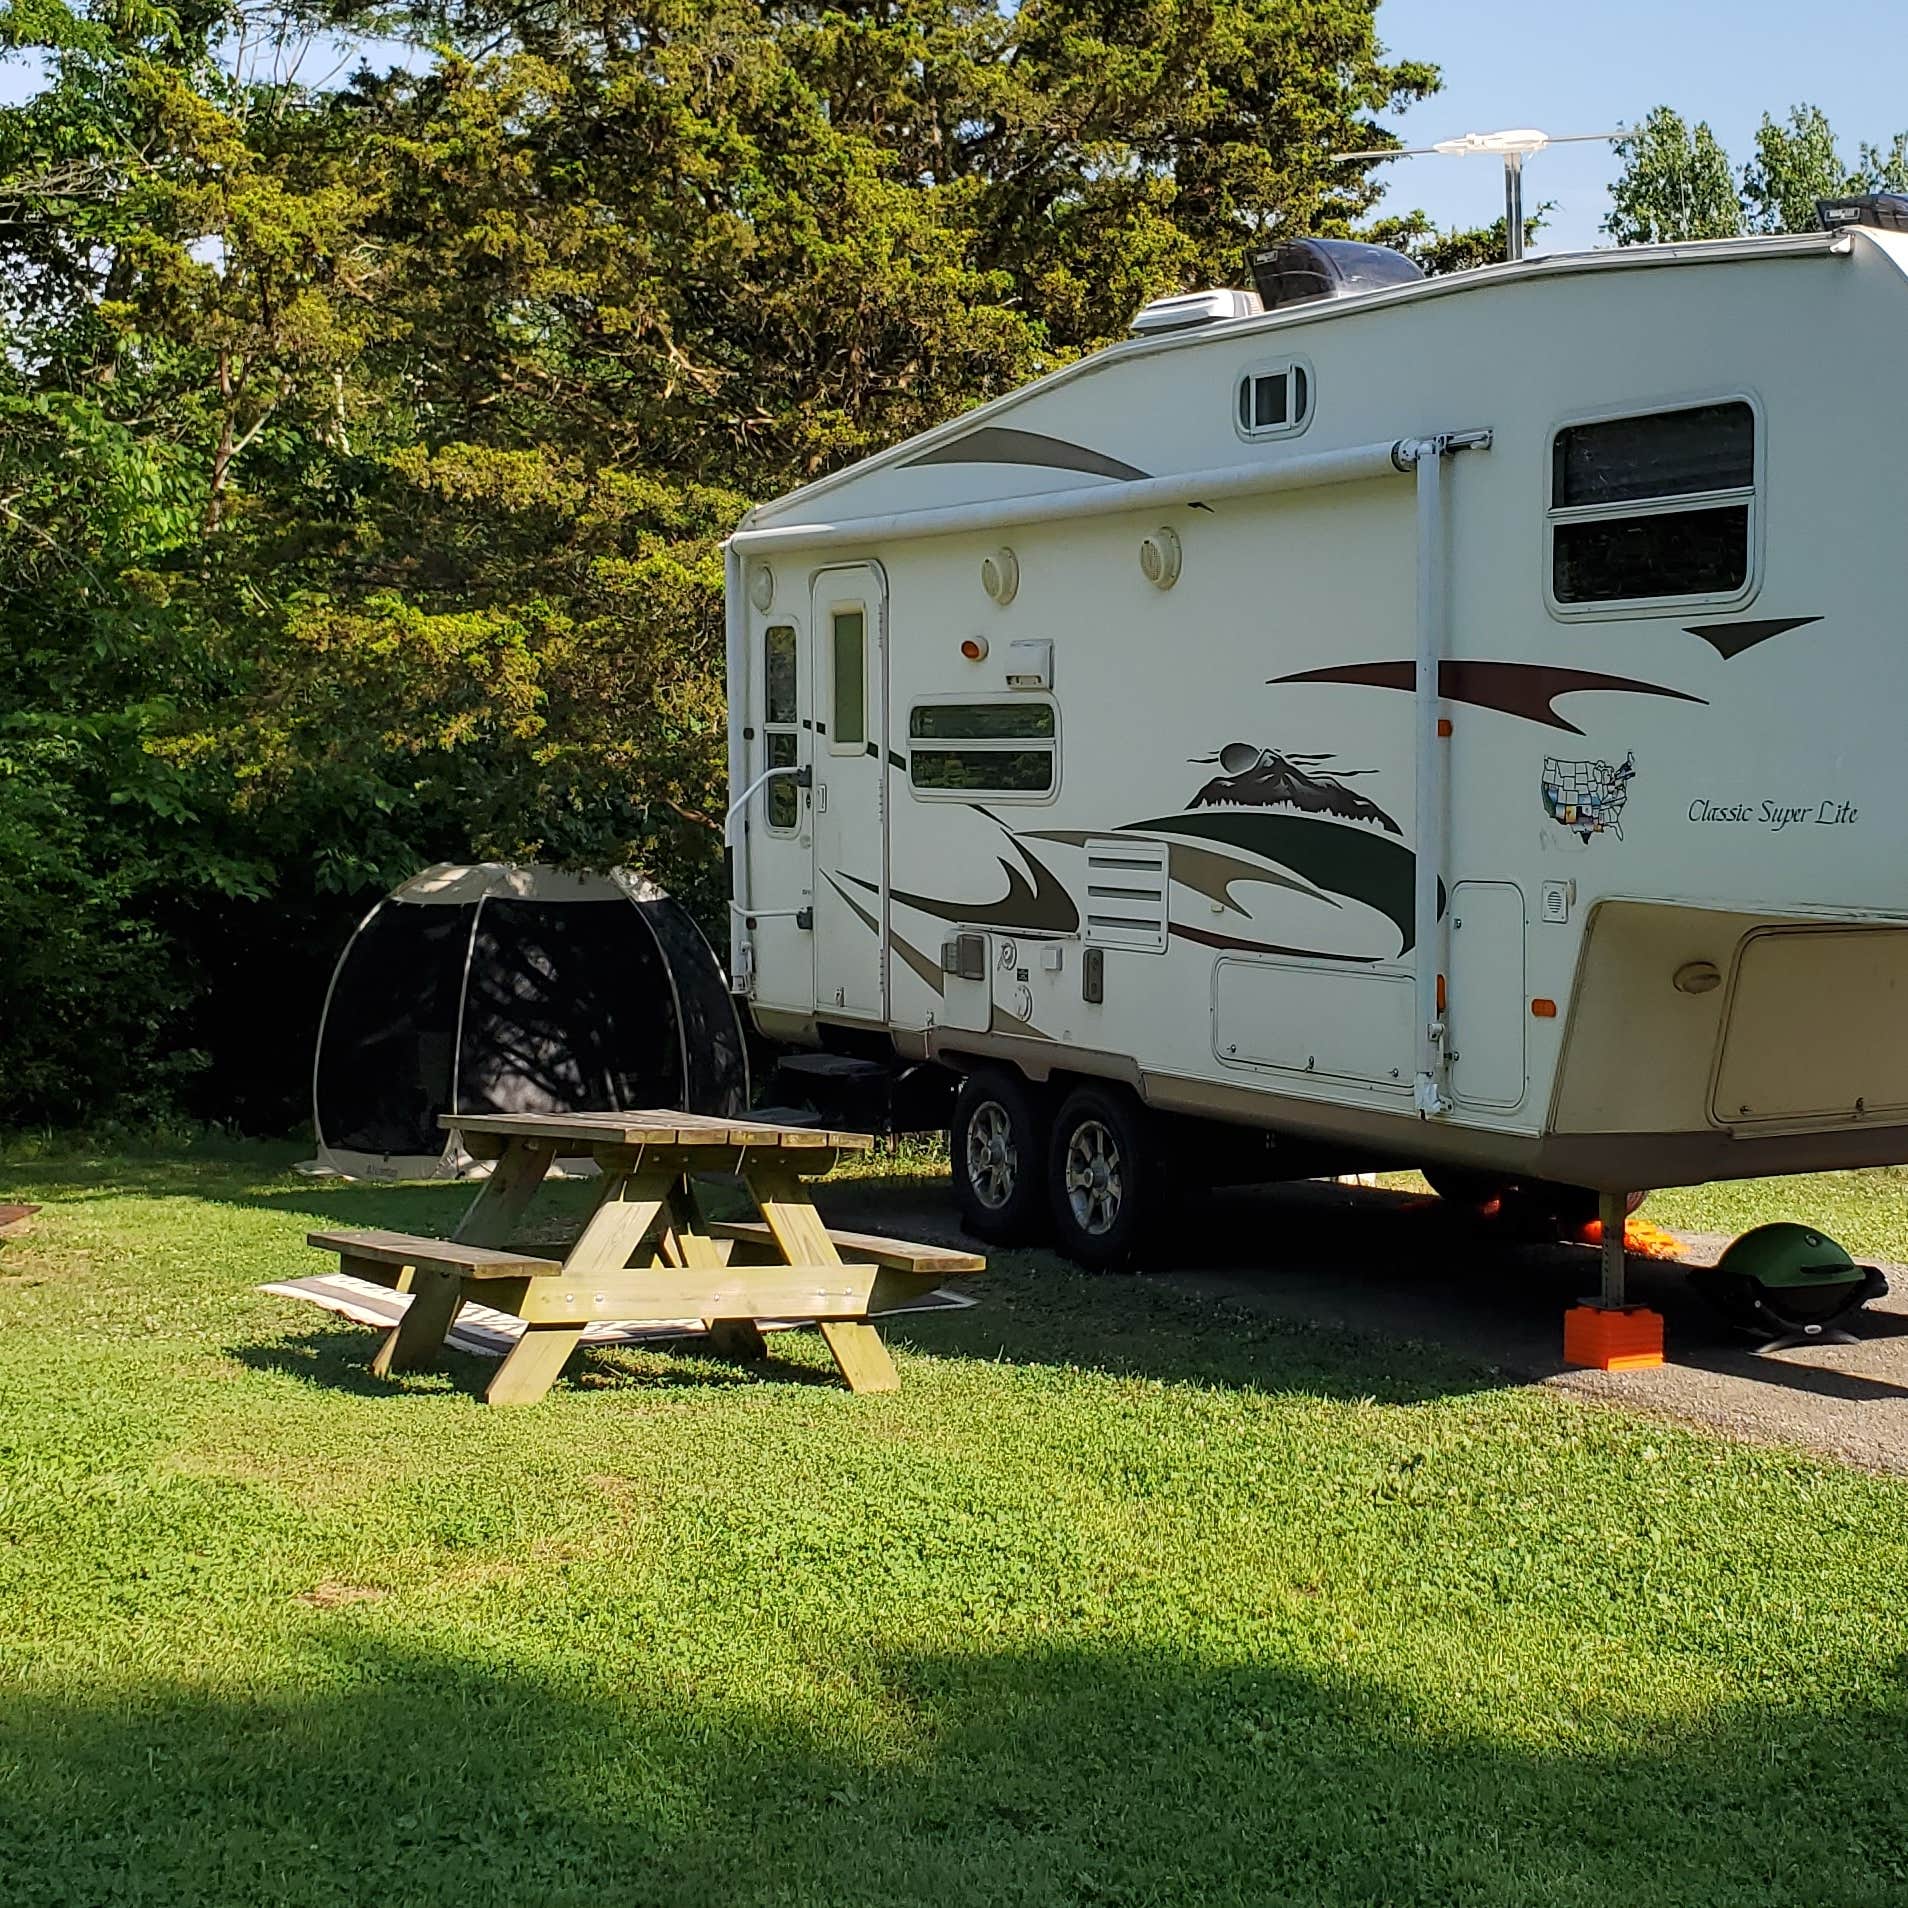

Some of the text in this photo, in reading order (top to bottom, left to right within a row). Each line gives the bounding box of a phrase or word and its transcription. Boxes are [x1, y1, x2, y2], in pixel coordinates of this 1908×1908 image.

[1688, 799, 1858, 832] Classic Super Lite
